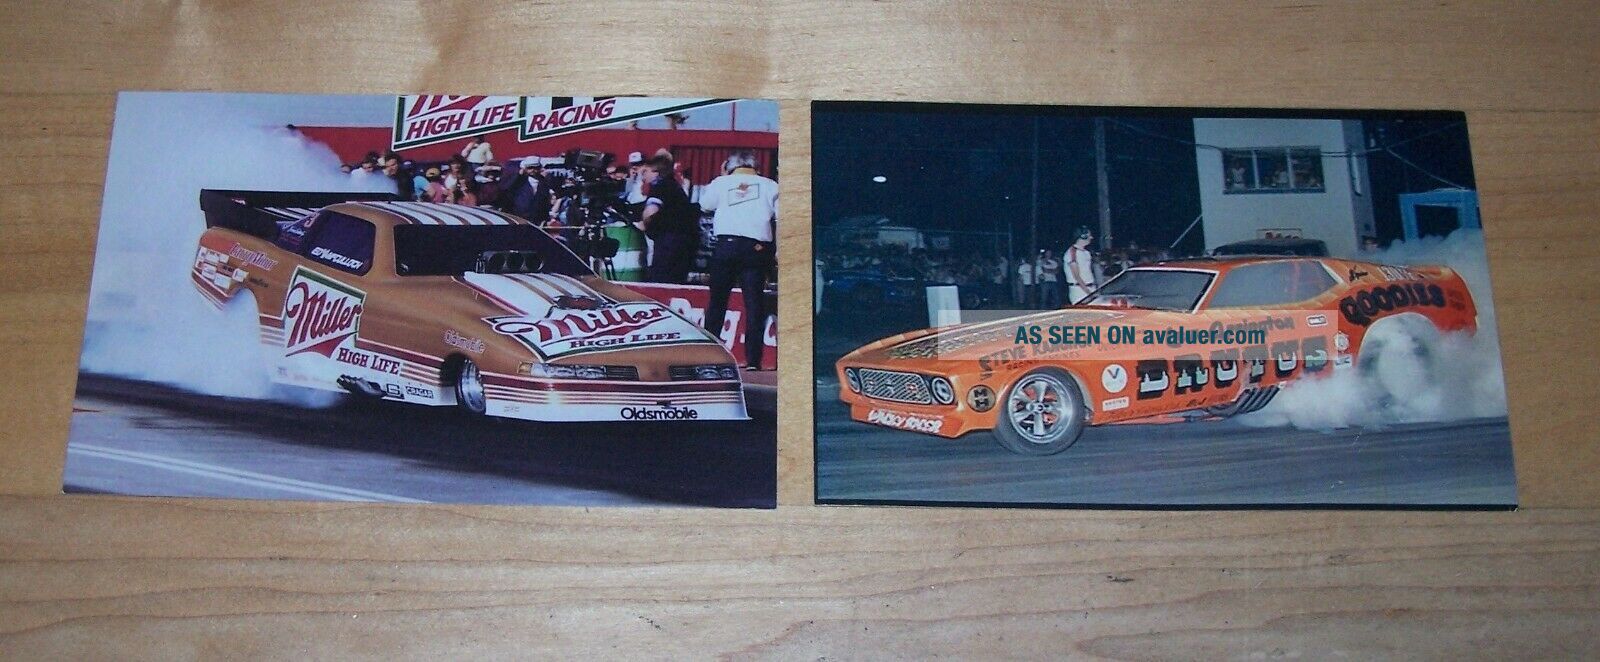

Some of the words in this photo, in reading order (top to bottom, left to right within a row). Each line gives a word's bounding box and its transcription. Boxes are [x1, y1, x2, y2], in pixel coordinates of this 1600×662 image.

[405, 112, 465, 141] HIGH
[468, 102, 518, 129] LIFE
[528, 98, 616, 133] RACING
[286, 282, 364, 348] Miller
[496, 305, 672, 343] Miller
[569, 336, 629, 349] HIGH
[630, 331, 681, 343] LIFE
[336, 347, 368, 367] HIGH
[370, 352, 401, 375] LIFE
[620, 405, 699, 421] Oldsmobile
